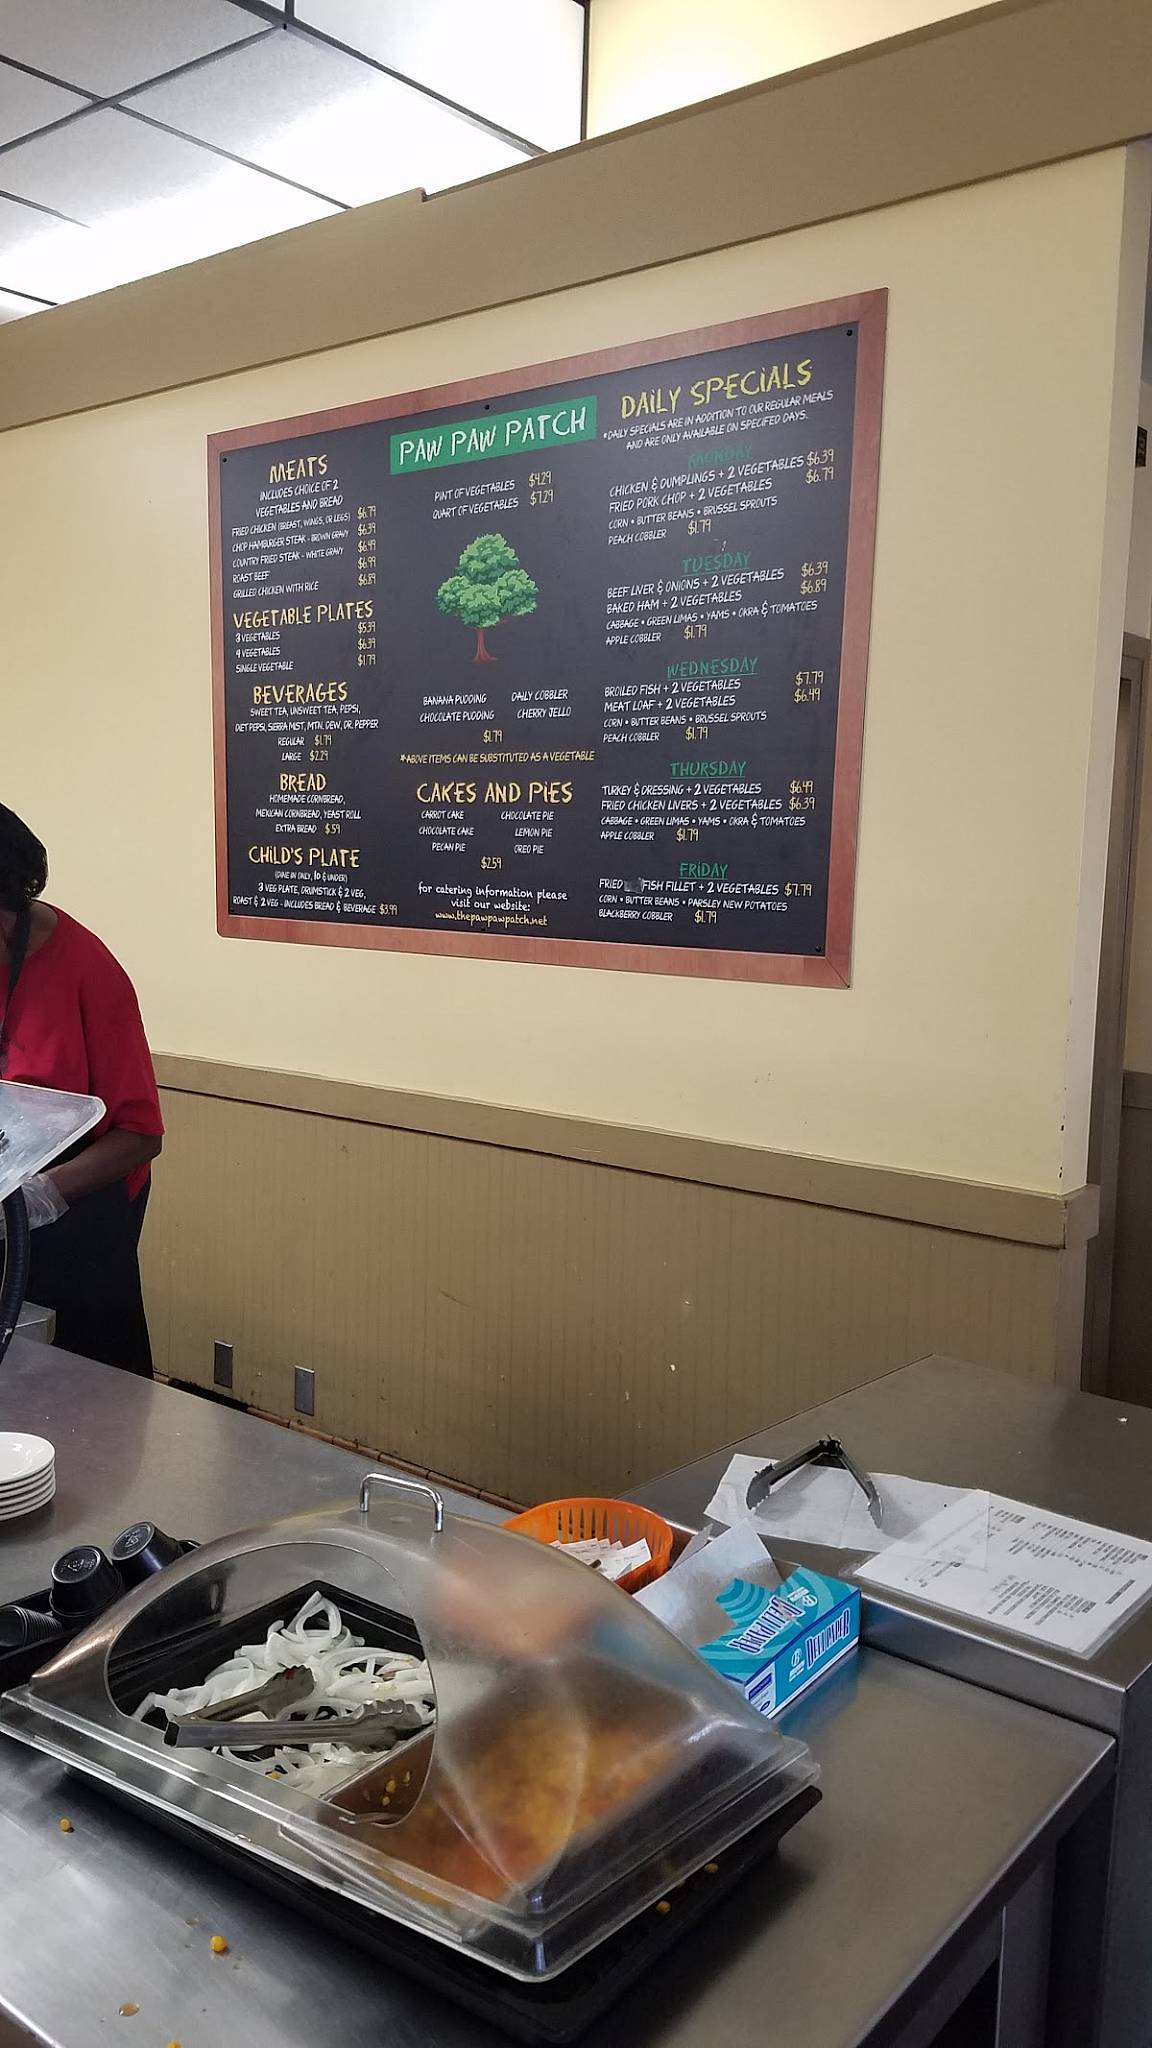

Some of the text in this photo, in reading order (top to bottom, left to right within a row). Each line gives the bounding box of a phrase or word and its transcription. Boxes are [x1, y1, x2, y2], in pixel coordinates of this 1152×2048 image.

[622, 359, 812, 419] DAILY SPECIALS
[400, 407, 586, 465] PAW PAW PATCH
[270, 454, 327, 483] MEATS
[610, 449, 833, 497] CHICKEN & DUMPLINGS 2 VEGETABLES $6.39
[260, 480, 338, 500] INCLUDES CHOICE OF 2
[435, 491, 452, 502] PINT
[454, 488, 465, 498] OF
[466, 480, 515, 497] VEGETABLES
[609, 467, 833, 513] FRIED PORK CHOP 2 VEGETABLES $6.79
[256, 495, 343, 517] VEGETABLES AND BREAD
[432, 508, 456, 520] QUART
[458, 505, 469, 515] OF
[469, 497, 518, 514] VEGETABLES
[609, 496, 777, 530] CORN BUTTER BEANS BRUSSEL SPROUTS
[682, 552, 751, 573] TUESDAY
[233, 572, 252, 583] ROAST
[254, 570, 270, 581] BEEF
[607, 561, 828, 598] BEEF LIVER & ONIONS 2 VEGETABLES $6.39
[233, 586, 257, 598] GRILLED
[258, 585, 284, 596] CHICKEN
[286, 583, 303, 593] WITH
[305, 581, 319, 591] RICE
[607, 579, 827, 614] BAKED HAM 2 VEGETABLES $6.89
[233, 600, 373, 628] VEGETABLE PLATES
[667, 657, 759, 678] WEDNESDAY
[253, 681, 348, 704] BEVERAGES
[605, 671, 823, 697] BROILED FISH 2 VEGETABLES $7.79
[423, 694, 487, 705] BANANA PUDDING
[511, 689, 568, 702] DAILY COBBLER
[604, 687, 821, 713] MEAT LOAF 2 VEGETABLES $6.49
[420, 711, 494, 723] CHOCOLATE PUDDING
[517, 707, 571, 718] CHERRY JELLO
[278, 736, 304, 746] REGULAR
[282, 752, 301, 761] LARGE
[670, 760, 746, 778] THURSDAY
[280, 773, 326, 792] BREAD
[602, 780, 813, 797] TURKEY & DRESSING 2 VEGETABLES $6.49
[417, 781, 573, 803] CAKES AND PIES
[601, 797, 815, 811] FRIED CHICKEN LIVERS 2 VEGETABLES $6.39
[421, 811, 464, 819] CARROT CAKE
[501, 811, 554, 820] CHOCOLATE PIE
[276, 824, 341, 834] EXTRA BREAD $.59
[419, 827, 474, 836] CHOCOLATE CAKE
[515, 828, 552, 837] LEMON PIE
[249, 845, 360, 868] CHILD'S PLATE
[432, 843, 466, 852] PECAN PIE
[514, 845, 544, 854] OREO PIE
[418, 882, 568, 904] for catering information please
[600, 879, 812, 897] FRIED FISH FILLET 2 VEGETABLES $7.79
[451, 899, 530, 911] visit our website:
[599, 896, 788, 911] CORN BUTTER BEANS PARSLEY NEW POTATOES
[435, 911, 547, 928] www.thepawpawpatch.net
[599, 909, 717, 924] BLACKBERRY COBBLER $1.79
